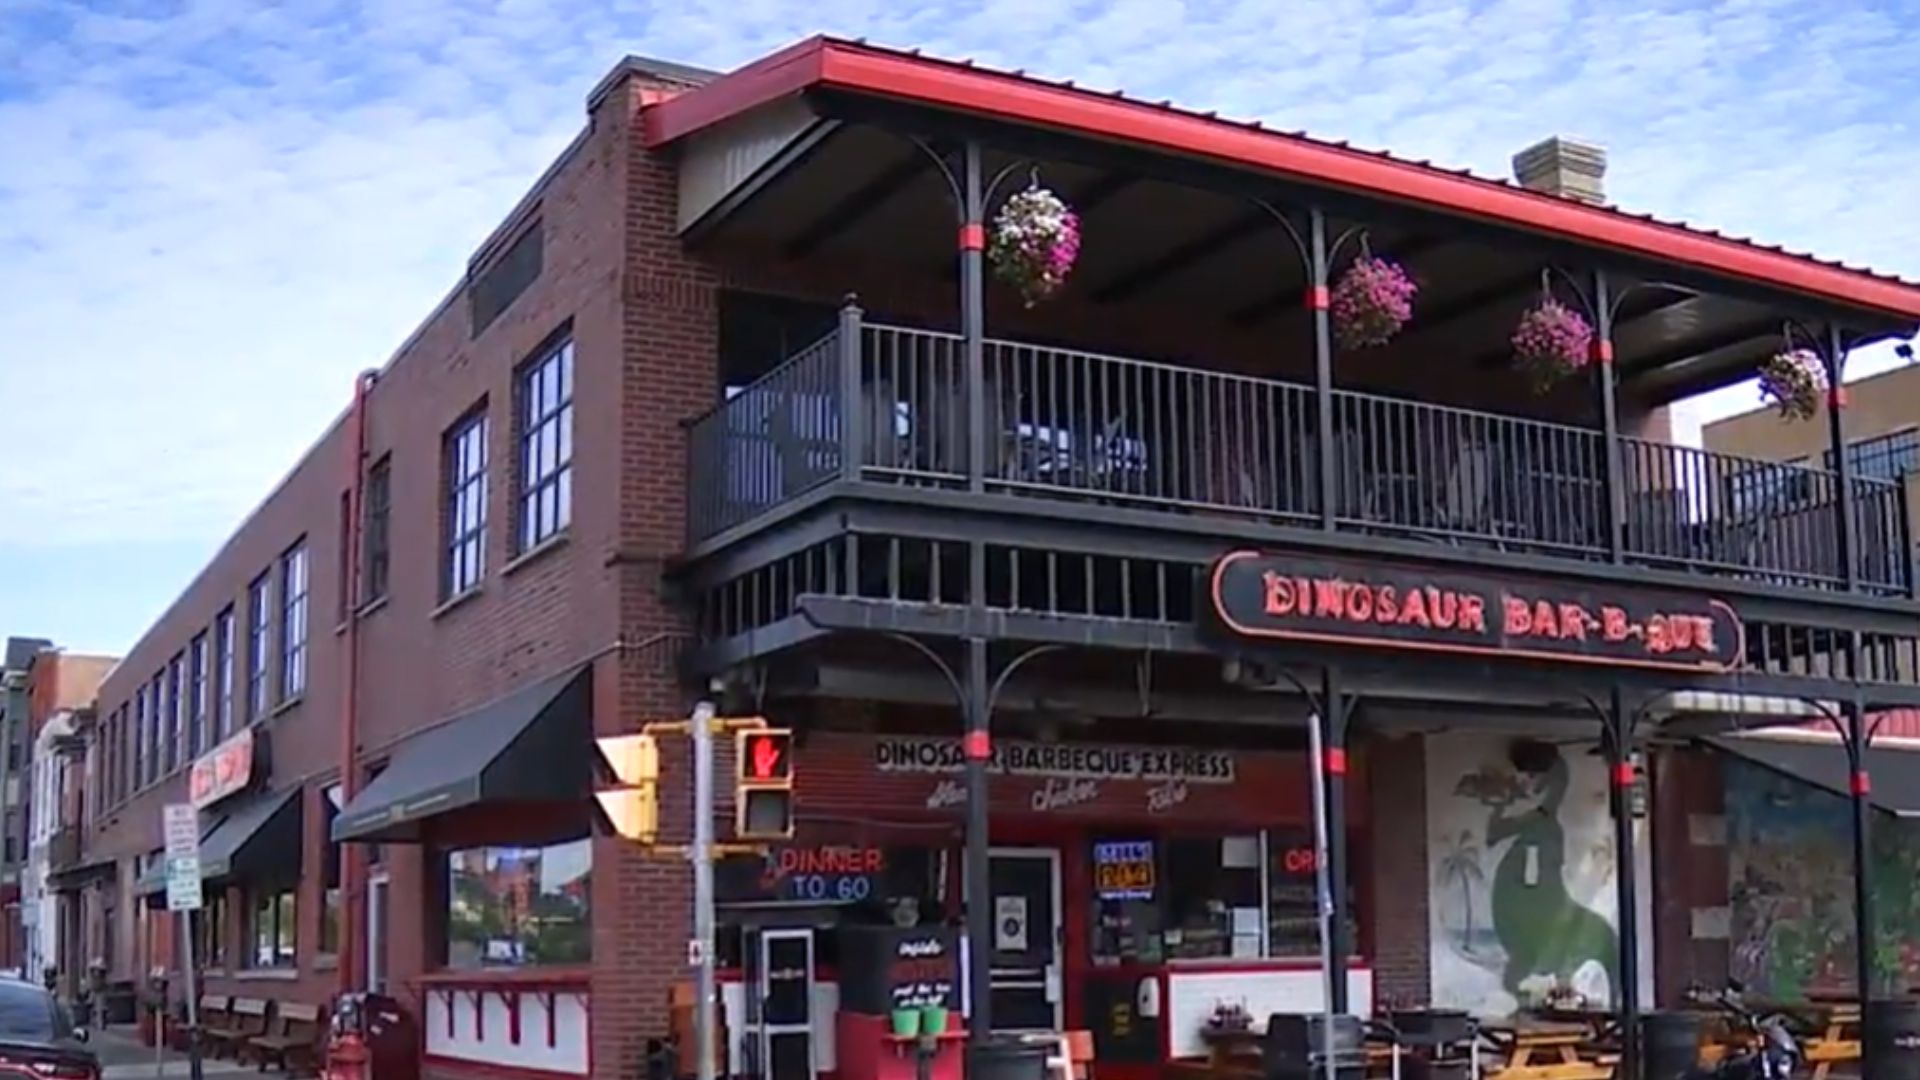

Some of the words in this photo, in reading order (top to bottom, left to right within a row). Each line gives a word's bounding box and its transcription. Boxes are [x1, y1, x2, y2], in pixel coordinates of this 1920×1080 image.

[1262, 569, 1485, 633] DINOSAUR
[1502, 596, 1717, 654] BAR-B-QUE
[876, 742, 999, 768] DINOSAR
[1009, 745, 1133, 774] BARBEQUE
[1140, 751, 1231, 777] EXPRESS
[780, 848, 883, 872] DINNER
[793, 874, 826, 898] TO
